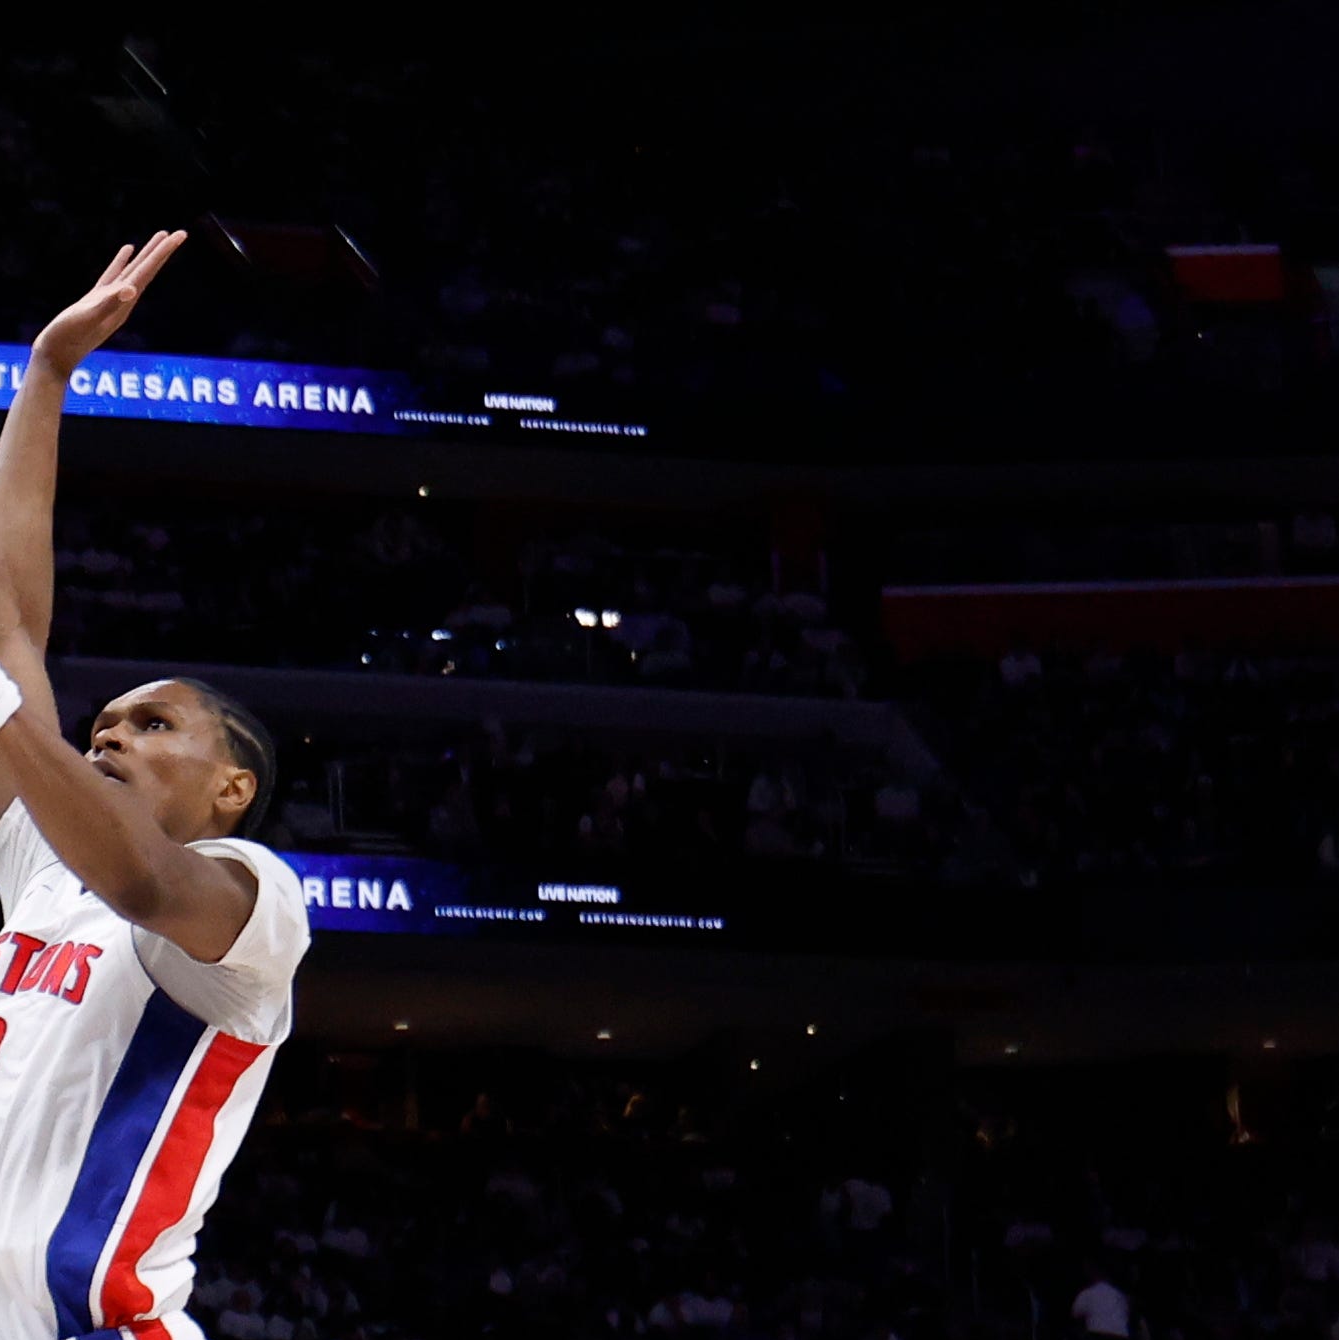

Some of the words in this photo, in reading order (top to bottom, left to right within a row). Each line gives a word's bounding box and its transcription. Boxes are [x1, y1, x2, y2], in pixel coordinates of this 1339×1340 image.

[69, 369, 238, 406] CAESARS
[253, 382, 374, 415] ARENA
[303, 877, 413, 911] RENA
[538, 885, 565, 900] LIVE
[566, 887, 619, 904] NATION
